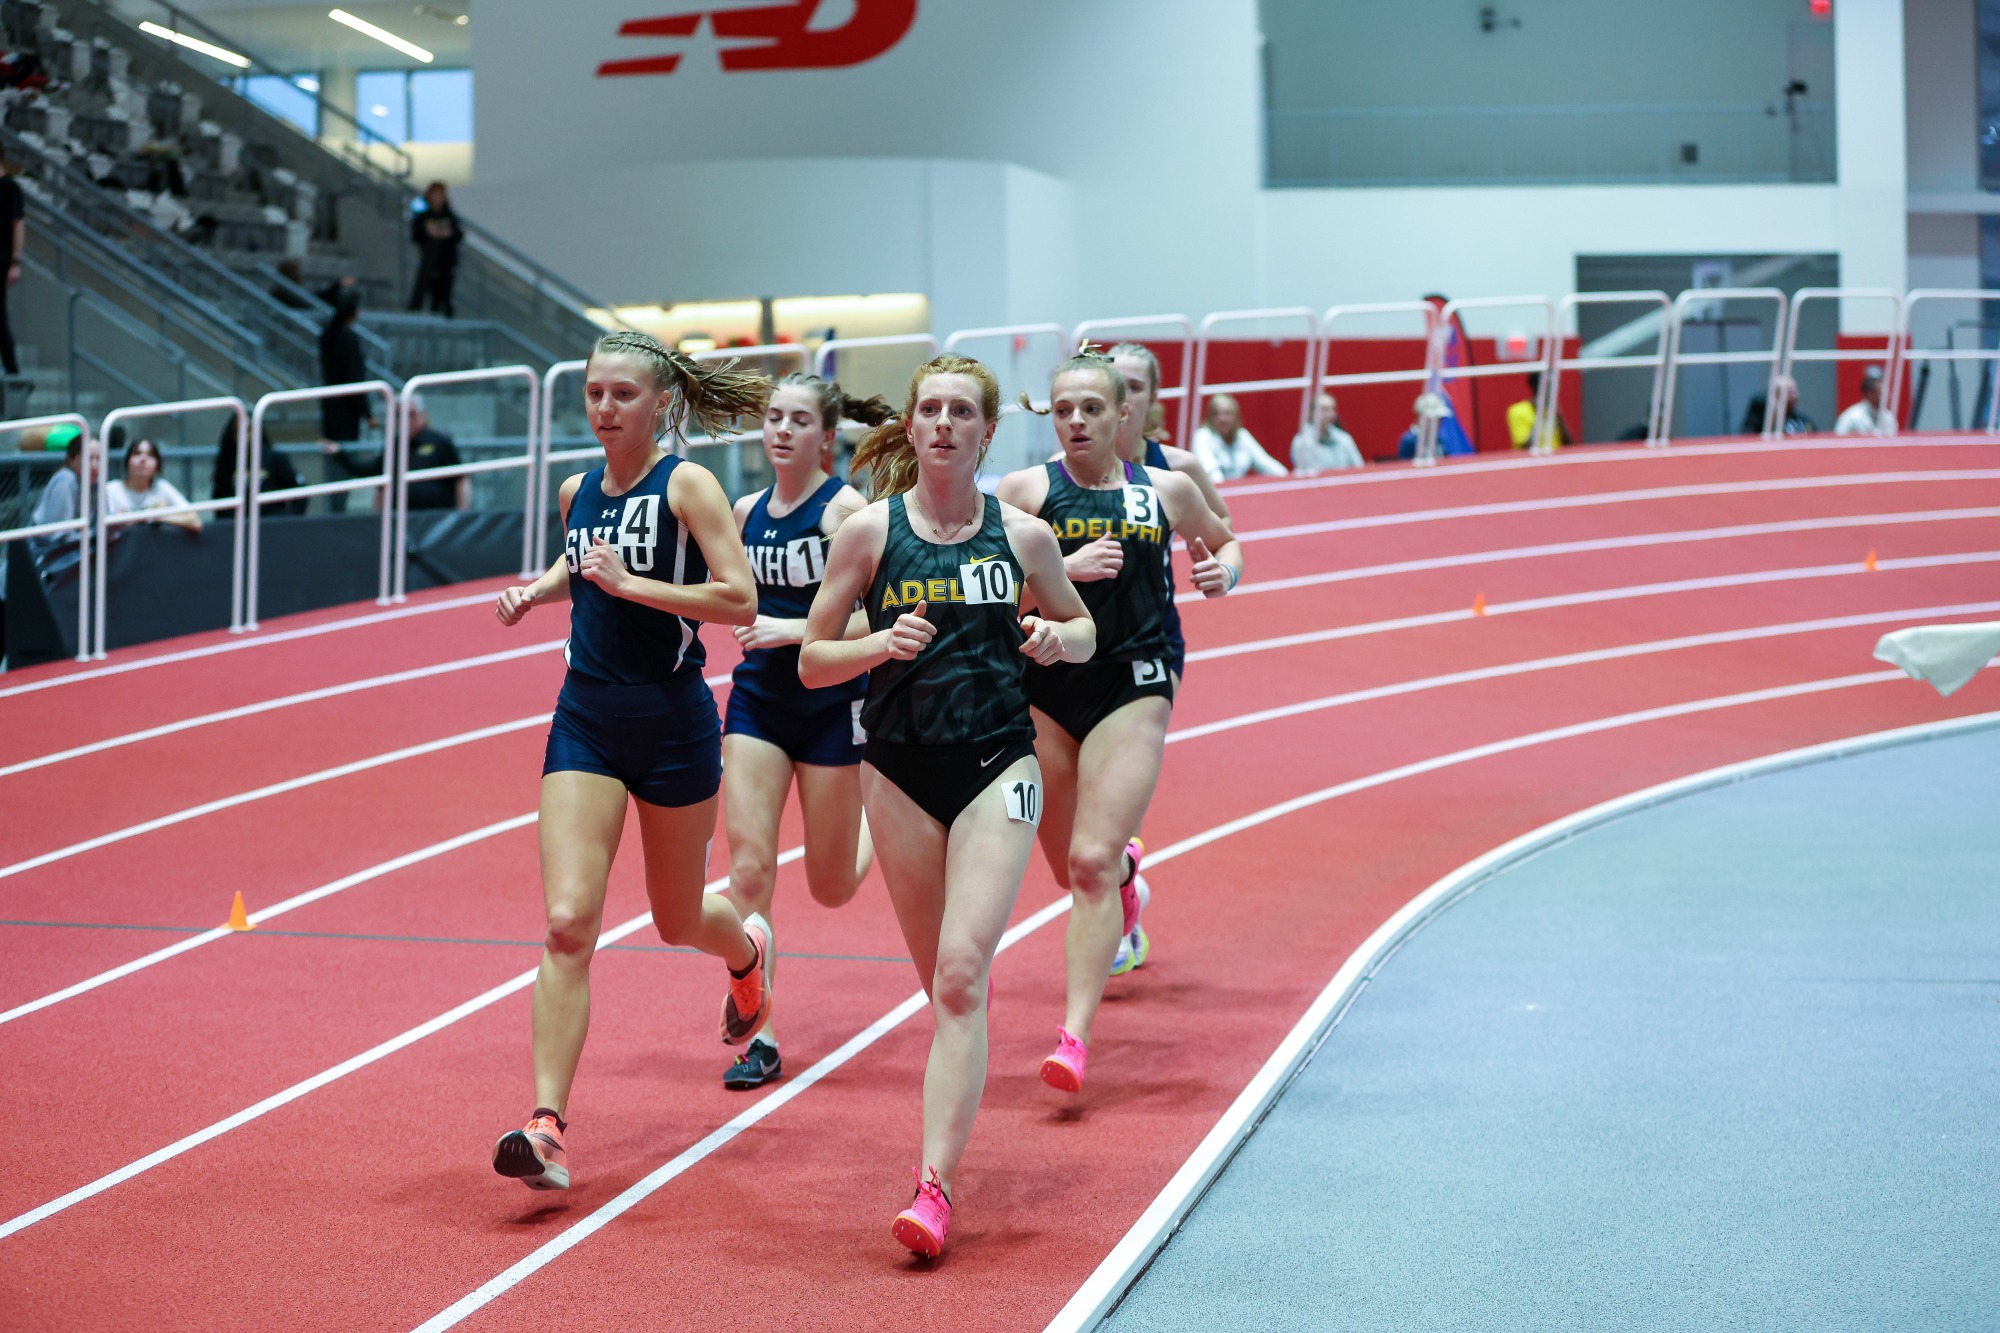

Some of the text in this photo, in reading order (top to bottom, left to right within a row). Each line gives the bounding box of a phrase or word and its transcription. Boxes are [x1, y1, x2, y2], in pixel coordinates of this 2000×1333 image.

[624, 498, 651, 545] 4
[1131, 487, 1152, 523] 3
[1050, 517, 1164, 545] ADELPHI
[797, 540, 816, 581] 1
[880, 577, 1020, 612] ADELI
[971, 562, 1009, 601] 10
[1012, 782, 1036, 822] 10
